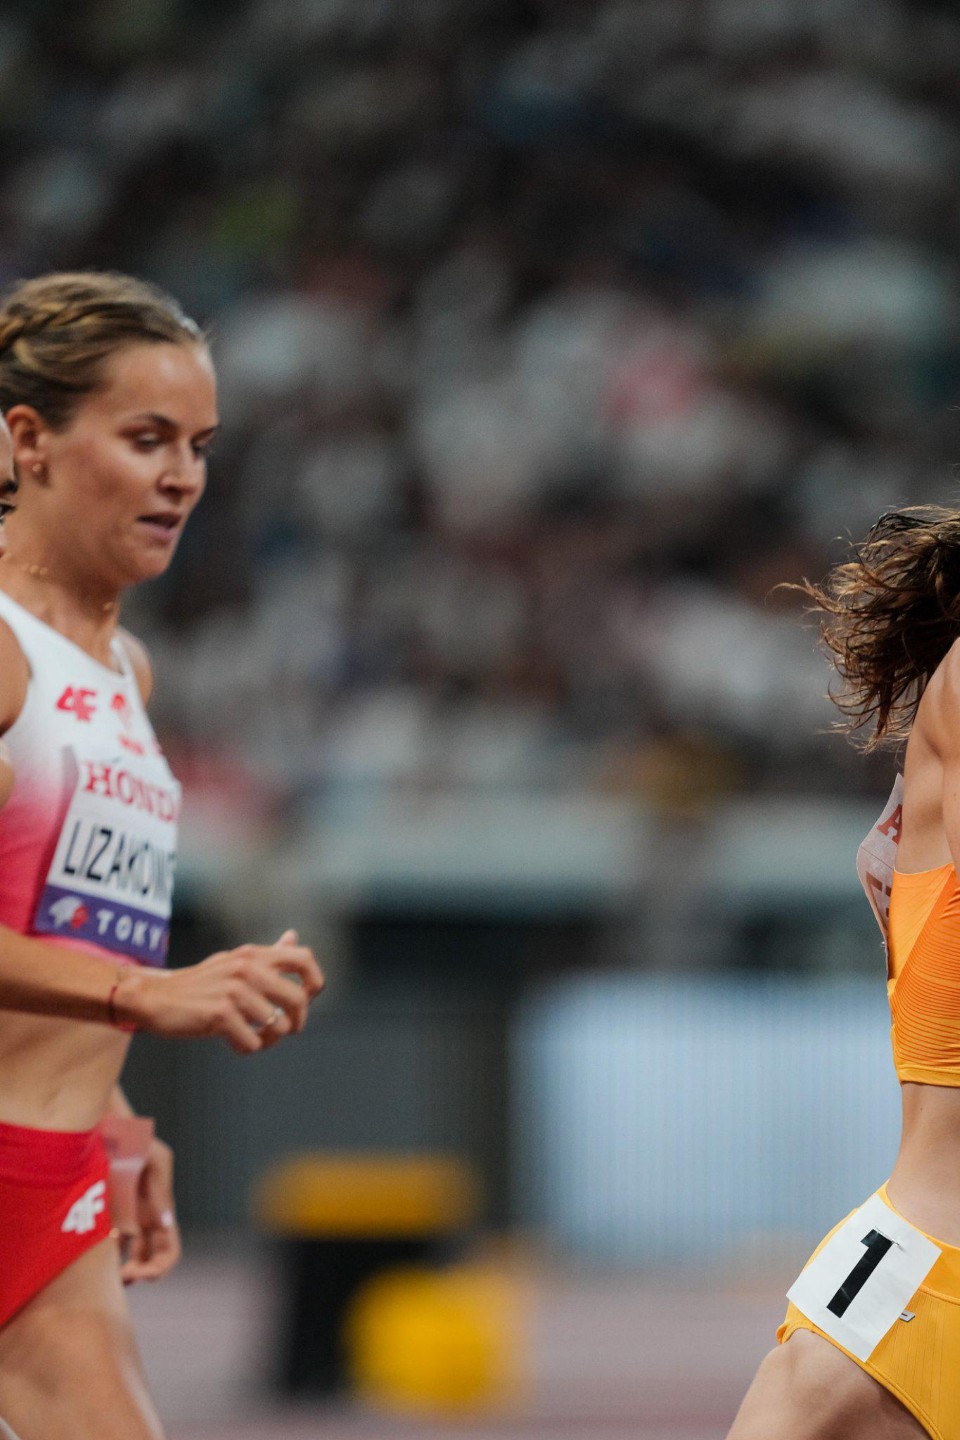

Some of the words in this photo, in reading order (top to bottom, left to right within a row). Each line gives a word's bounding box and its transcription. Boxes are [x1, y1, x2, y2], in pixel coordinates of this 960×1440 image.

[85, 762, 178, 823] HOND
[96, 909, 168, 951] TOKY
[827, 1228, 895, 1319] 1
